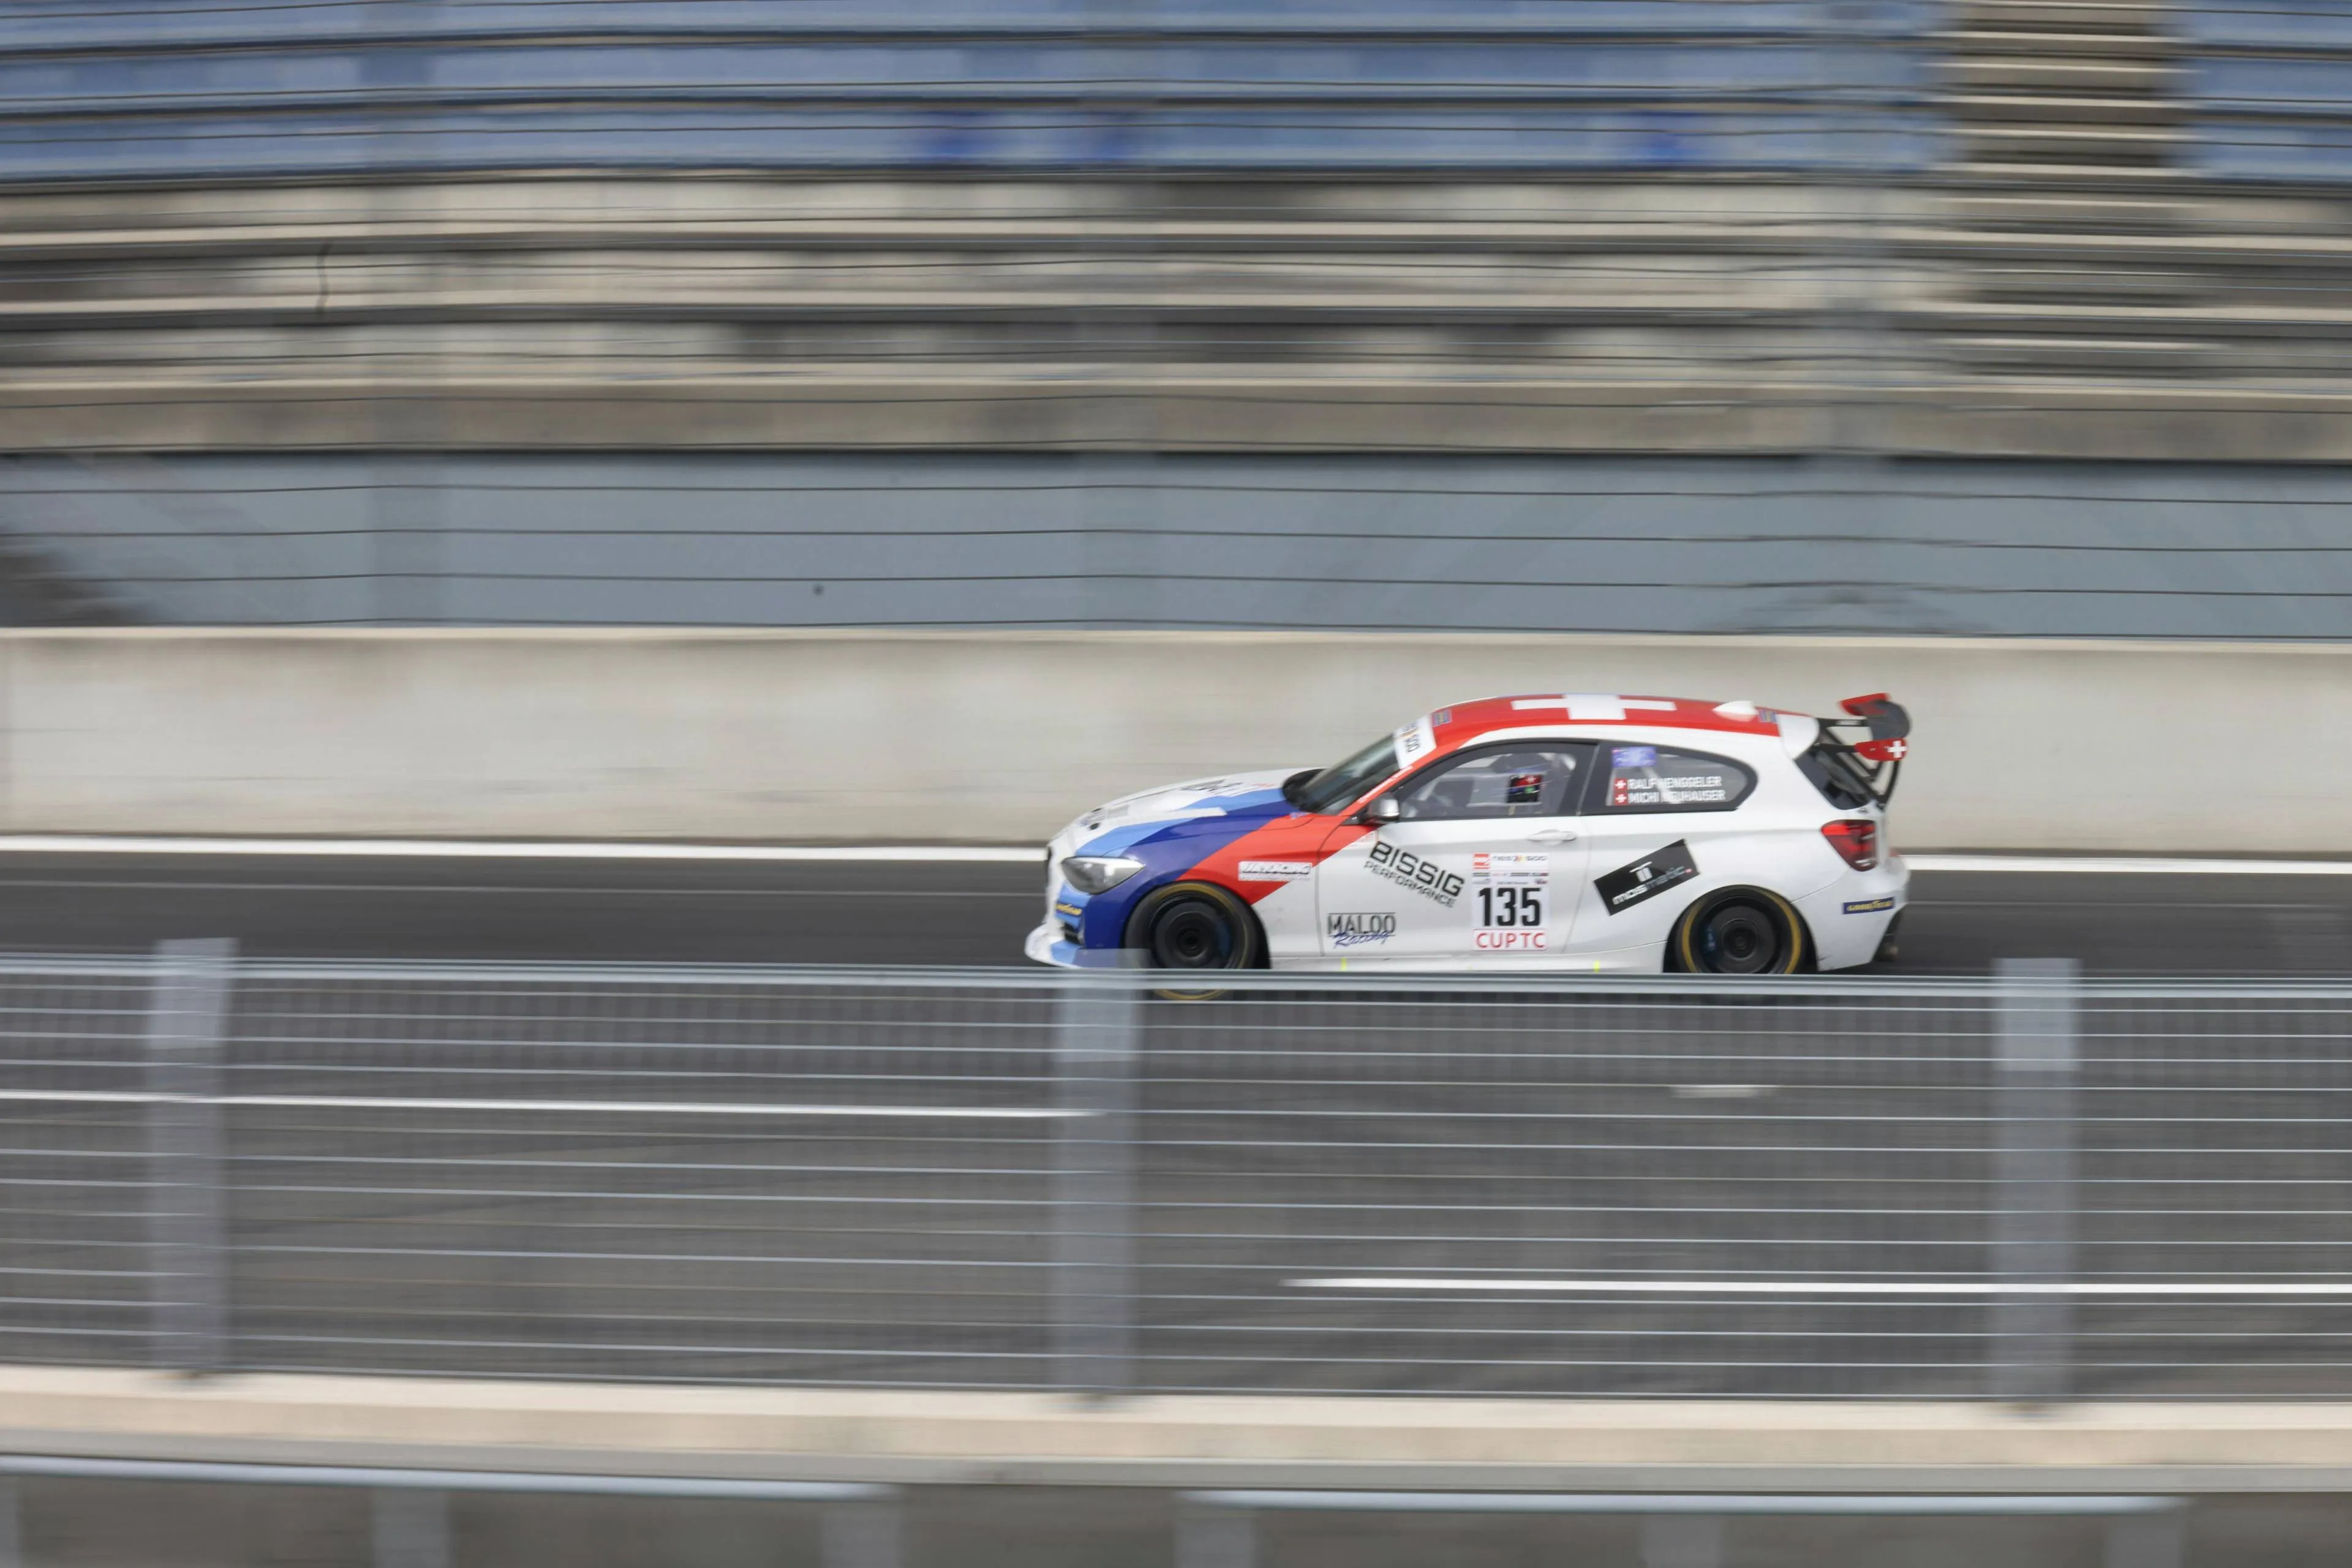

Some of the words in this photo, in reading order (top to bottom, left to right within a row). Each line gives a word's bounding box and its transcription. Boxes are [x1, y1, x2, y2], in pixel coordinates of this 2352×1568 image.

[1627, 778, 1656, 790] RALF
[1363, 861, 1457, 908] PERFORMANCE
[1370, 840, 1465, 897] BISSIG
[1478, 888, 1542, 926] 135
